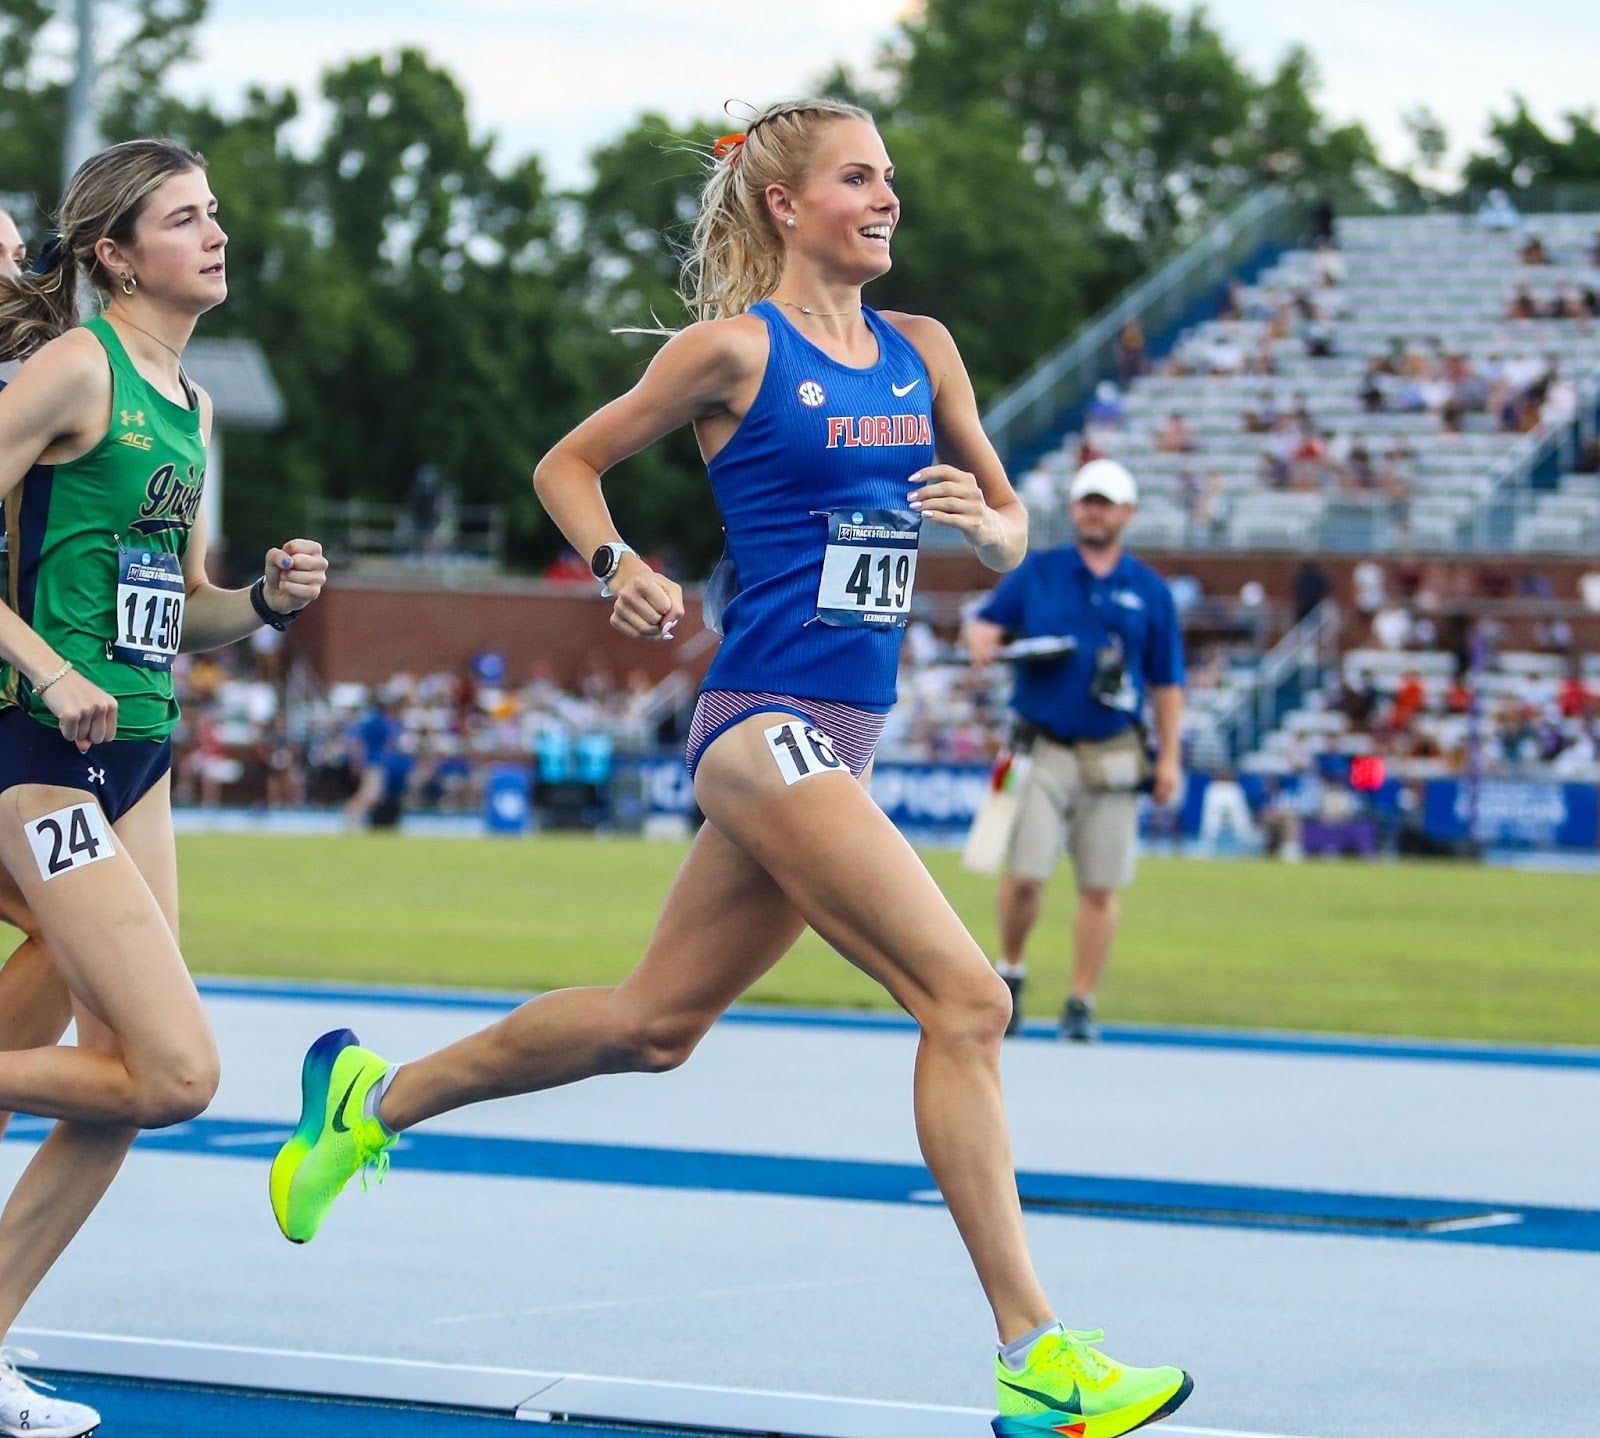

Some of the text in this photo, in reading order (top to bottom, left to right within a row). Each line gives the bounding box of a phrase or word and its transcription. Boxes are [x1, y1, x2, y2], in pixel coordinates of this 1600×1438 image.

[800, 381, 825, 406] SEC
[119, 432, 154, 451] ACC
[826, 414, 932, 449] FLORIDA
[852, 528, 872, 538] TRACK
[876, 530, 890, 539] FIELD
[845, 553, 909, 608] 419
[125, 592, 180, 650] 1158
[773, 725, 840, 776] 16
[36, 808, 100, 875] 24
